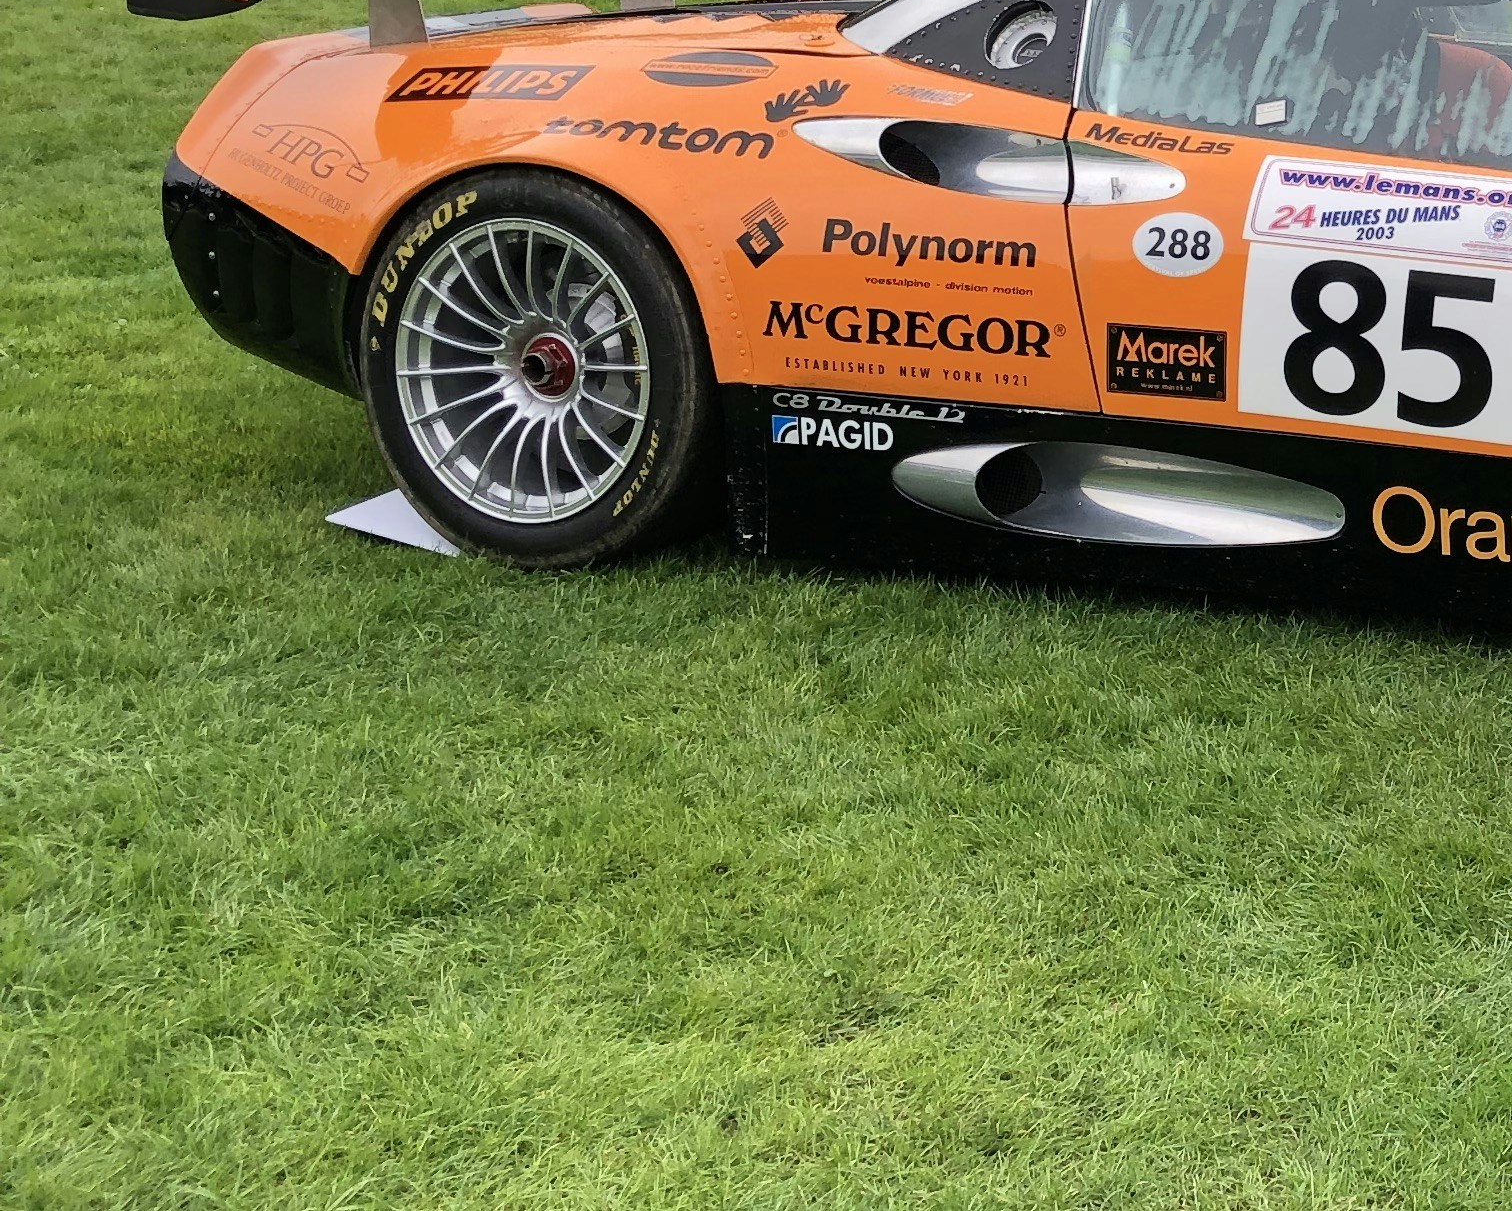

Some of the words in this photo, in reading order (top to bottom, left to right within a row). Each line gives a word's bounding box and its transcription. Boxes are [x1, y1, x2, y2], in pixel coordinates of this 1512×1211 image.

[400, 70, 578, 97] PHILIPS
[266, 128, 345, 179] HPG
[542, 116, 774, 159] tomtom
[281, 172, 320, 199] PROJECT
[319, 191, 351, 215] GROEP
[1268, 205, 1317, 230] 24
[1320, 208, 1381, 228] HEURES
[1385, 207, 1413, 225] DU
[1413, 204, 1462, 223] MANS
[1356, 226, 1395, 241] 2003
[371, 190, 478, 327] DUNLOP
[821, 218, 1037, 268] Polynorm
[1145, 226, 1211, 261] 288
[864, 276, 931, 288] voestalpine
[945, 281, 989, 293] division
[992, 285, 1033, 296] motion
[1116, 330, 1216, 368] Marek
[1284, 260, 1496, 428] 85
[785, 356, 886, 376] ESTABLISHED
[899, 365, 931, 379] NEW
[942, 368, 983, 384] YORK
[994, 372, 1029, 387] 1921
[1116, 366, 1216, 384] REKLAME
[772, 392, 810, 409] C8
[816, 395, 925, 418] Double
[936, 406, 966, 424] 12
[801, 415, 894, 451] PAGID
